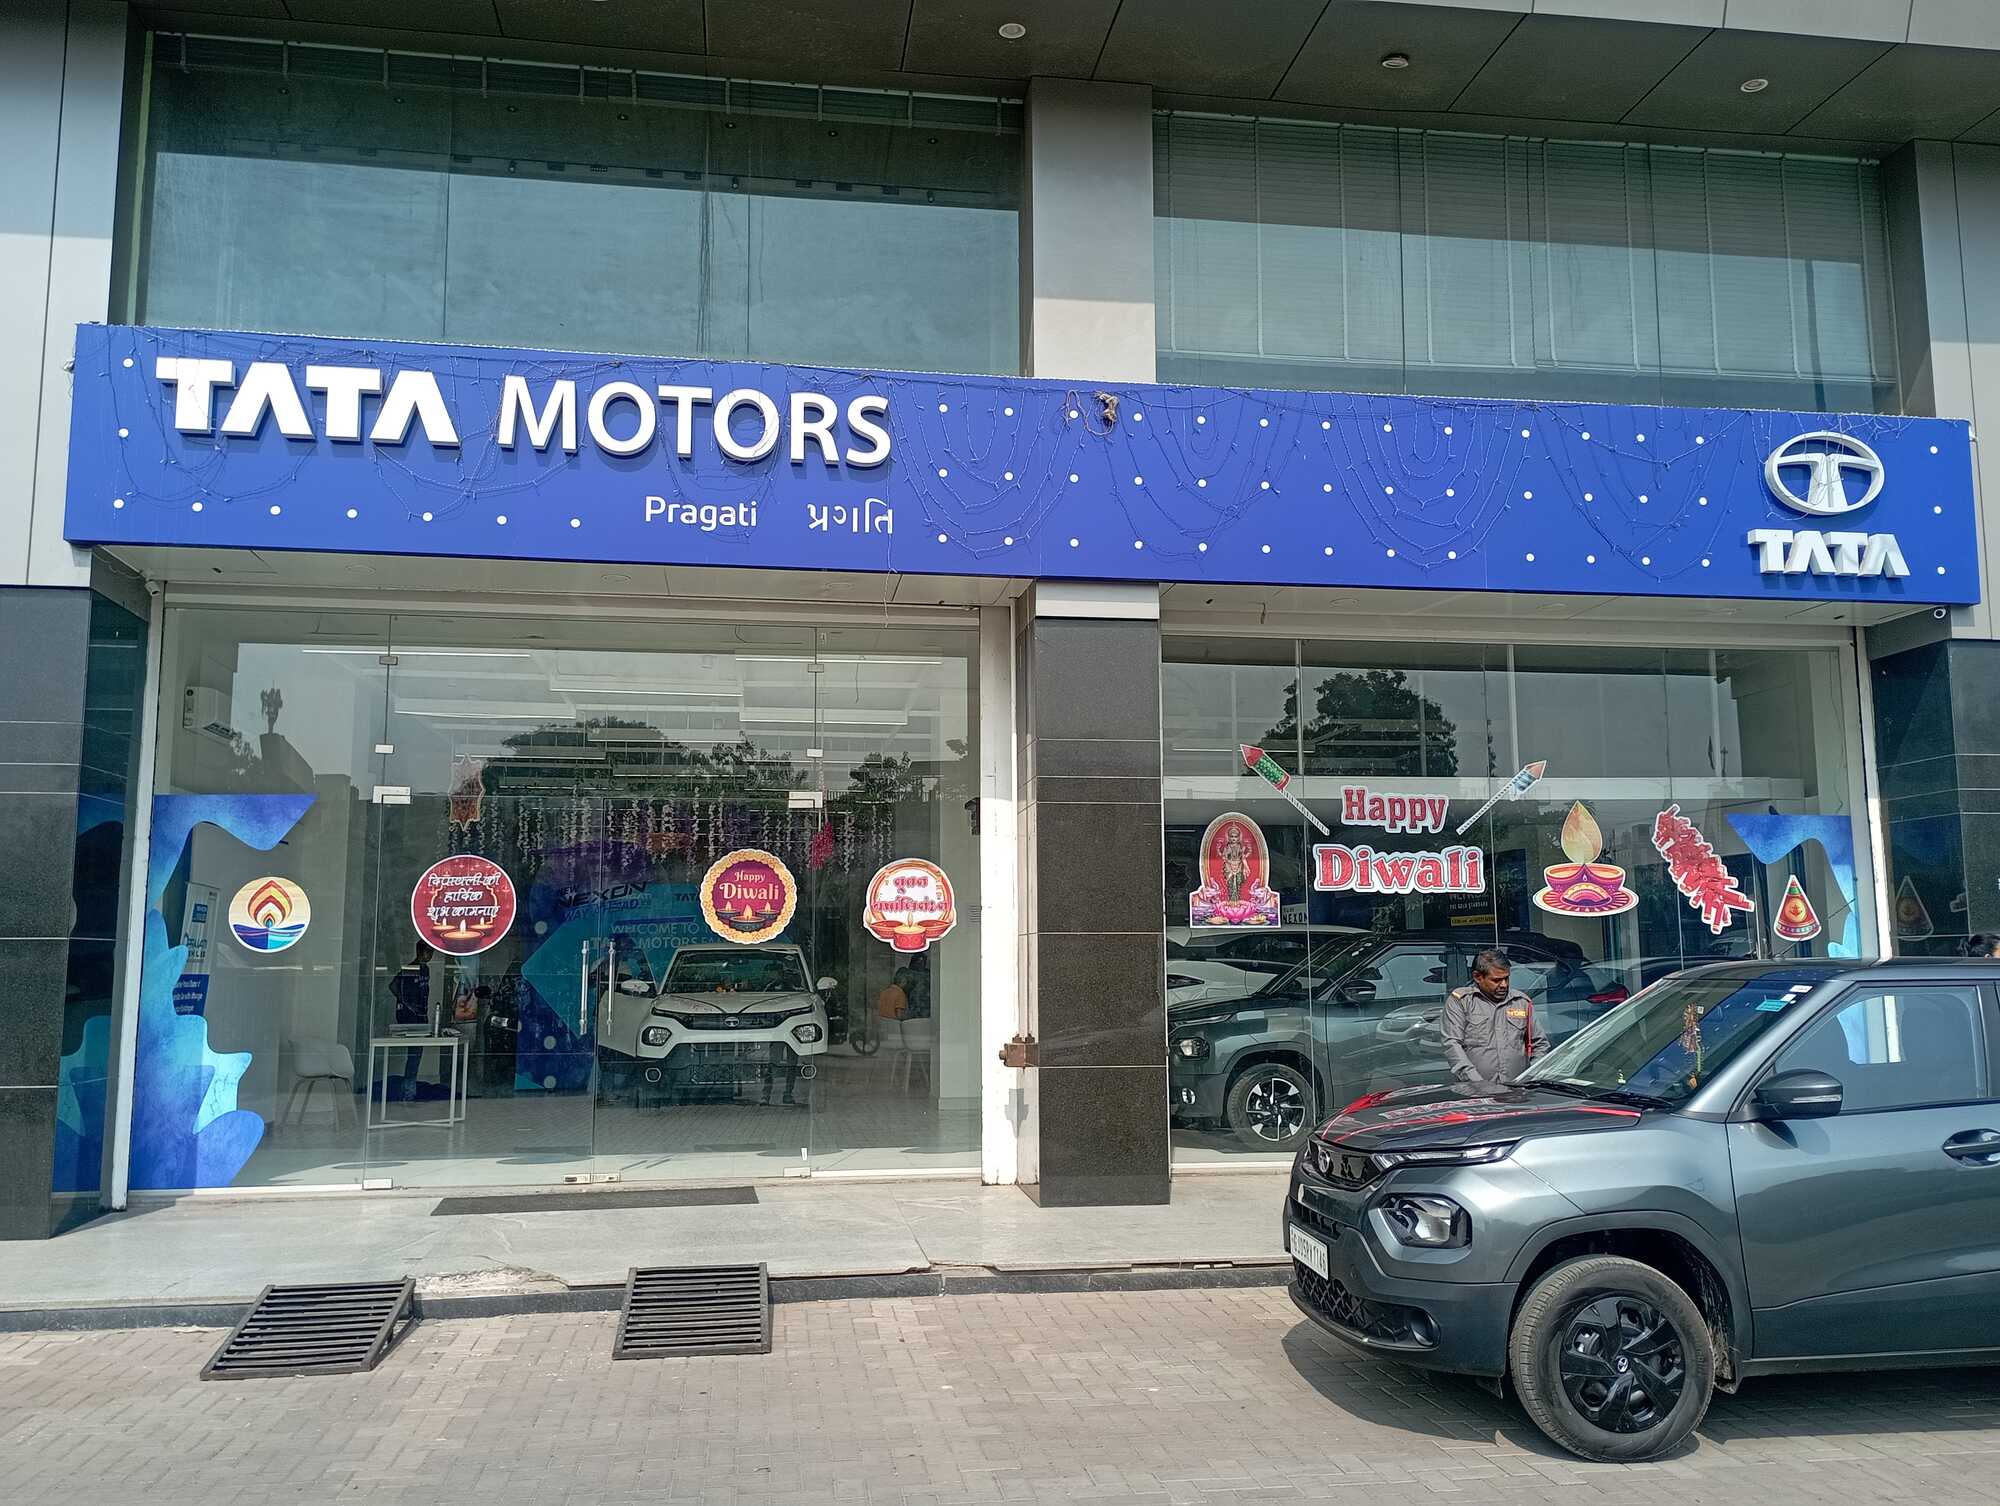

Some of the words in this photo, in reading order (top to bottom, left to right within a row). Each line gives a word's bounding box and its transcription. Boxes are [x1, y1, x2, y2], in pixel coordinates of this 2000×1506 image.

[155, 357, 460, 446] TATA
[498, 375, 892, 467] MOTORS
[644, 495, 757, 532] Pragati
[807, 498, 893, 534] પ્રગતિ
[1747, 529, 1910, 578] TATA
[1343, 788, 1447, 831] Happy
[734, 870, 766, 883] Happy
[1318, 847, 1482, 889] Diwali
[559, 881, 647, 907] NEXON
[719, 883, 779, 900] Diwali
